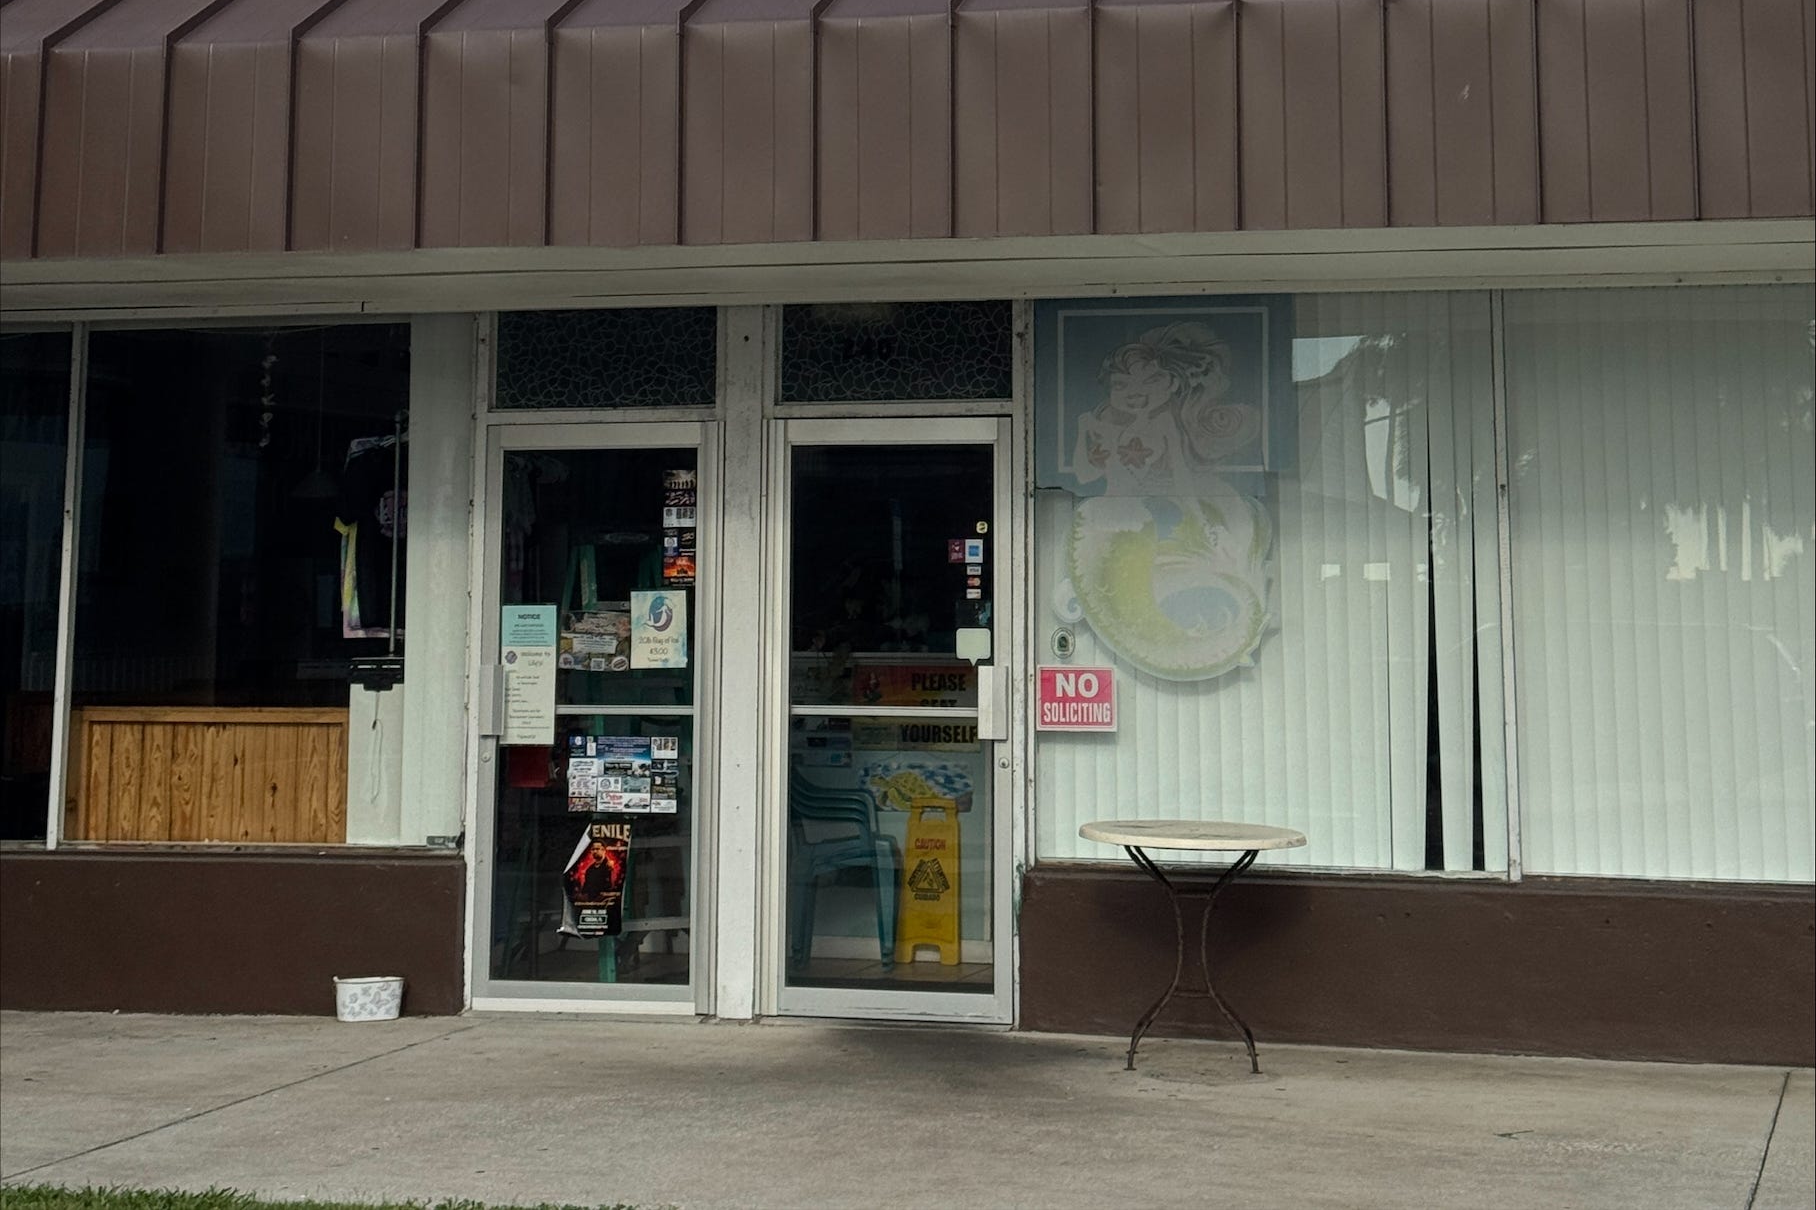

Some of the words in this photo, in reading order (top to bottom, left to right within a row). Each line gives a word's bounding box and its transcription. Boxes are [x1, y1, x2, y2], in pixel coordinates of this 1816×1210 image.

[911, 673, 966, 691] PLEASE
[1055, 673, 1099, 698] NO
[1043, 702, 1111, 723] SOLICITING
[900, 724, 978, 743] YOURSELF
[914, 837, 947, 851] CAUTION
